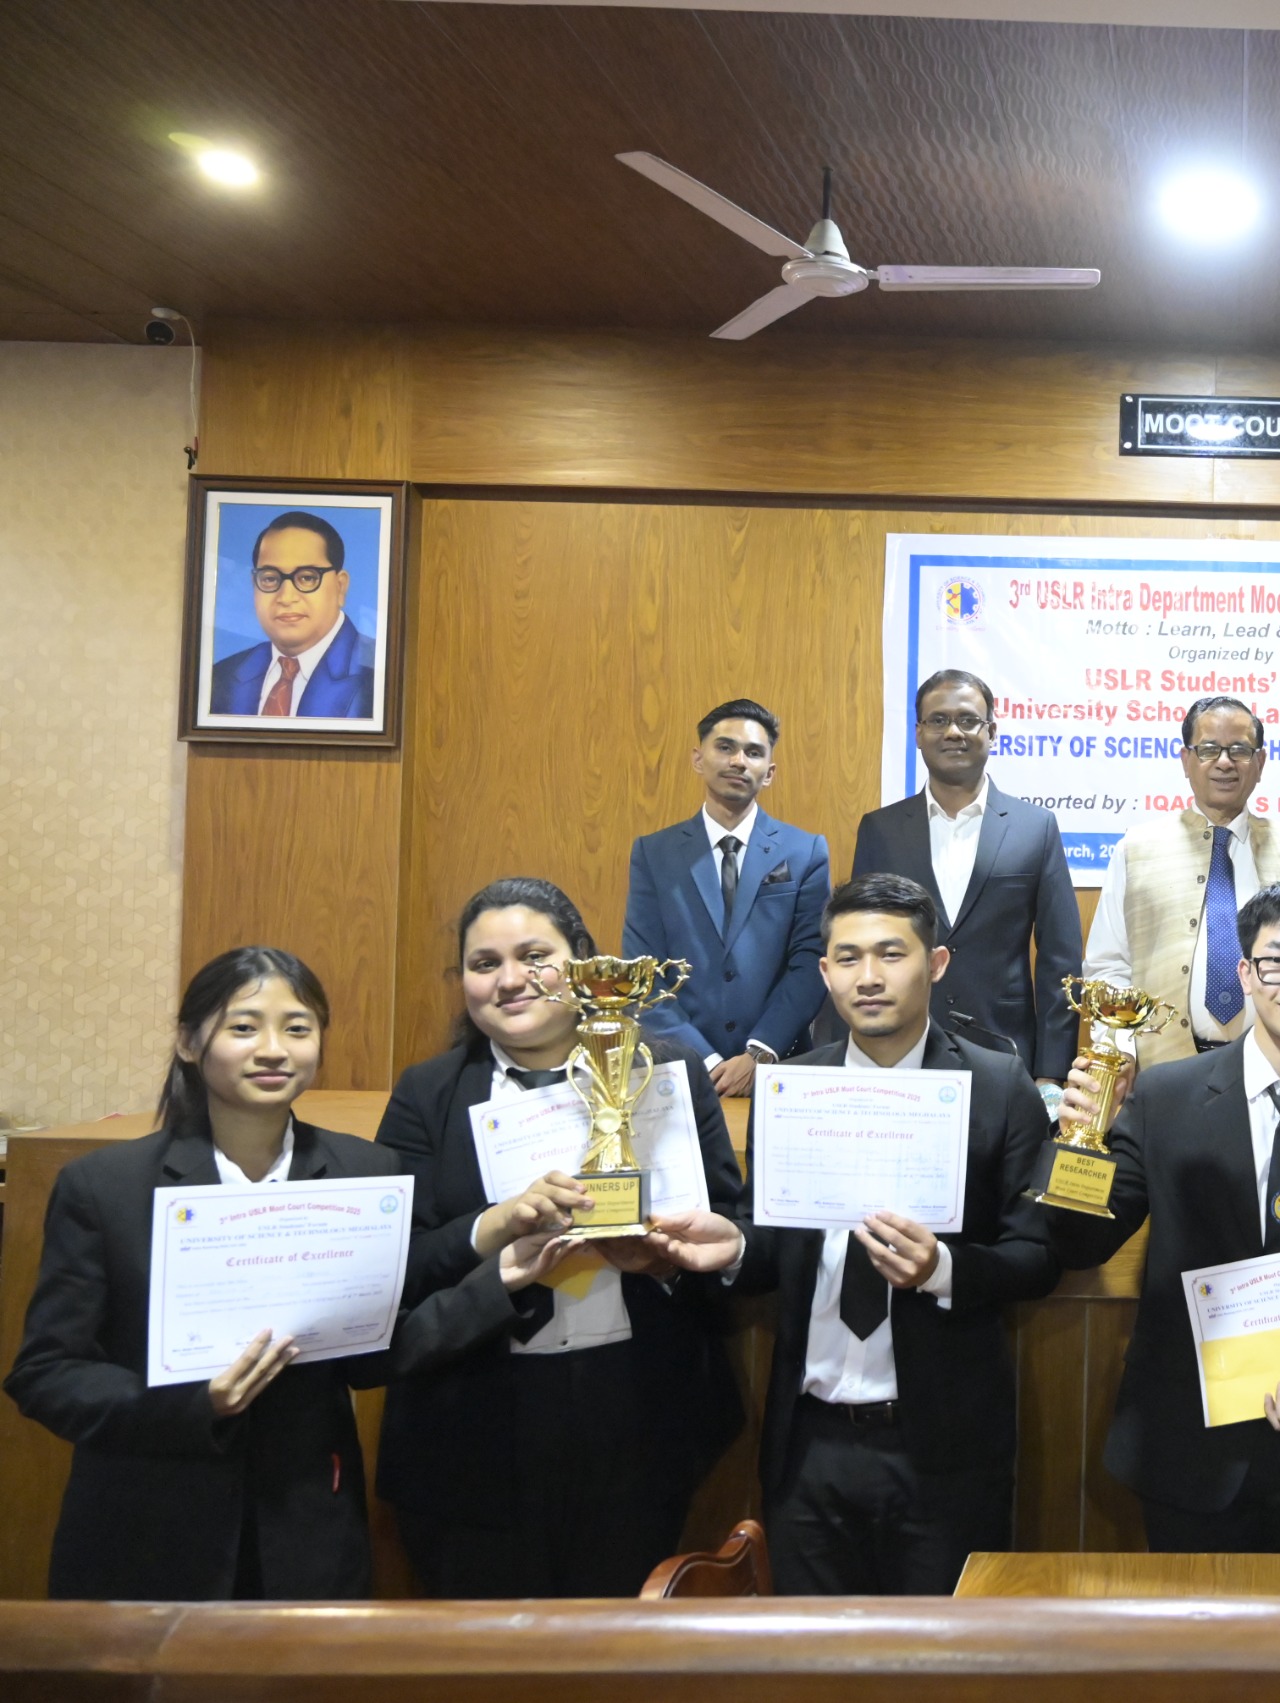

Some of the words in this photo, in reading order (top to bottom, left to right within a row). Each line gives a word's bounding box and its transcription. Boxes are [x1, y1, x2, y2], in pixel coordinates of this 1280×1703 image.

[1009, 579, 1031, 609] 3rd
[1037, 581, 1085, 610] USLR
[1091, 582, 1133, 611] Intra
[1139, 582, 1245, 619] Department
[1086, 619, 1140, 636] Motto
[1157, 621, 1217, 639] Learn,
[1222, 622, 1271, 638] Lead
[1168, 645, 1250, 663] Organized
[1254, 647, 1274, 664] by
[1085, 668, 1152, 692] USLR
[993, 697, 1118, 726] University
[1126, 702, 1186, 723] Scho
[1069, 736, 1097, 758] OF
[1104, 737, 1182, 760] SCIENC
[1102, 795, 1127, 813] by
[873, 1086, 906, 1098] Competition
[807, 1127, 852, 1138] Certificate
[855, 1130, 864, 1138] of
[866, 1130, 914, 1139] Excellence
[1076, 1156, 1096, 1167] BEST
[1059, 1163, 1108, 1181] RESEARCHER
[584, 1181, 620, 1192] UNNERS
[623, 1181, 635, 1191] UP
[230, 1212, 246, 1221] Intra
[248, 1206, 267, 1216] USLR
[269, 1204, 286, 1212] Moot
[307, 1202, 345, 1212] Competition
[346, 1206, 362, 1216] 2025
[225, 1255, 284, 1267] Certificate
[287, 1252, 298, 1262] of
[301, 1249, 354, 1261] Excellence
[1264, 1272, 1277, 1280] Moot
